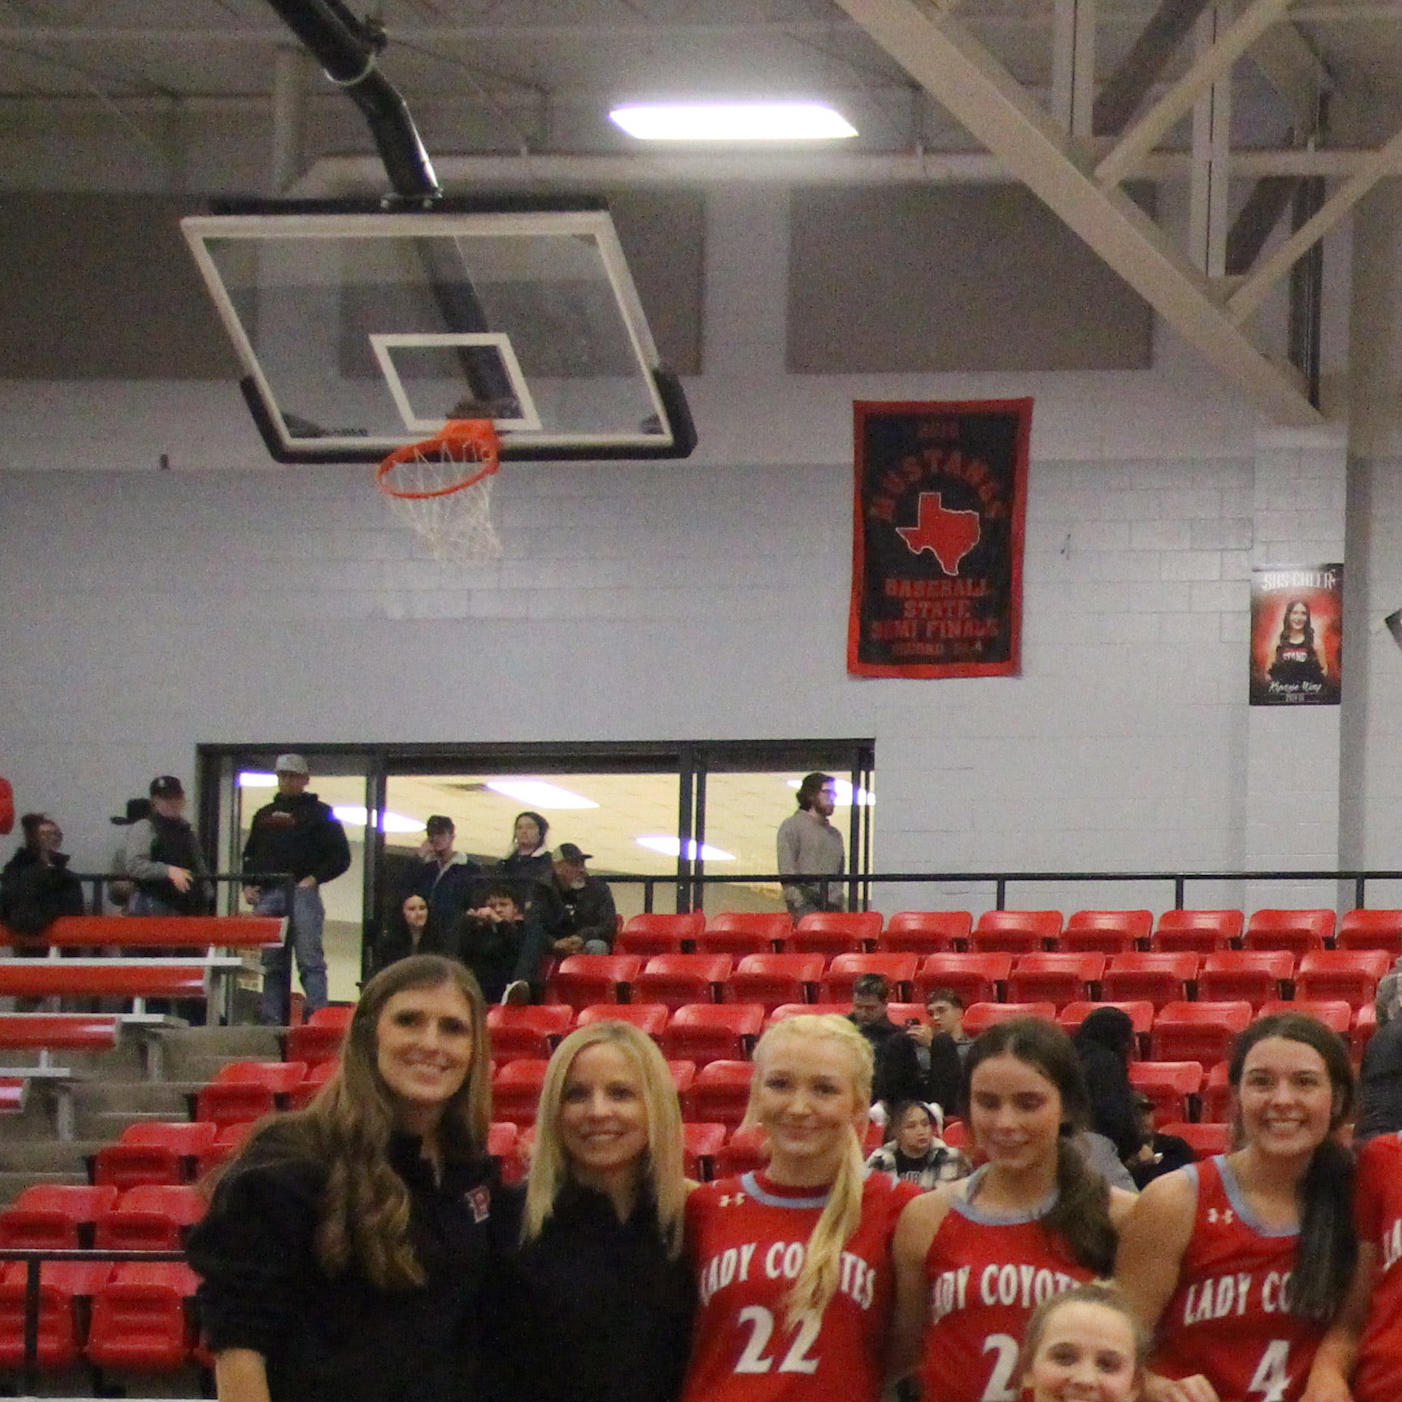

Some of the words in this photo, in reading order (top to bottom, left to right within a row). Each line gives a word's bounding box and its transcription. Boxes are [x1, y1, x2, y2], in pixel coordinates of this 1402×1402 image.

[702, 1241, 749, 1306] LADY
[765, 1241, 874, 1309] COTES
[1184, 1272, 1250, 1326] LADY
[733, 1306, 823, 1374] 22
[1247, 1339, 1292, 1402] 4
